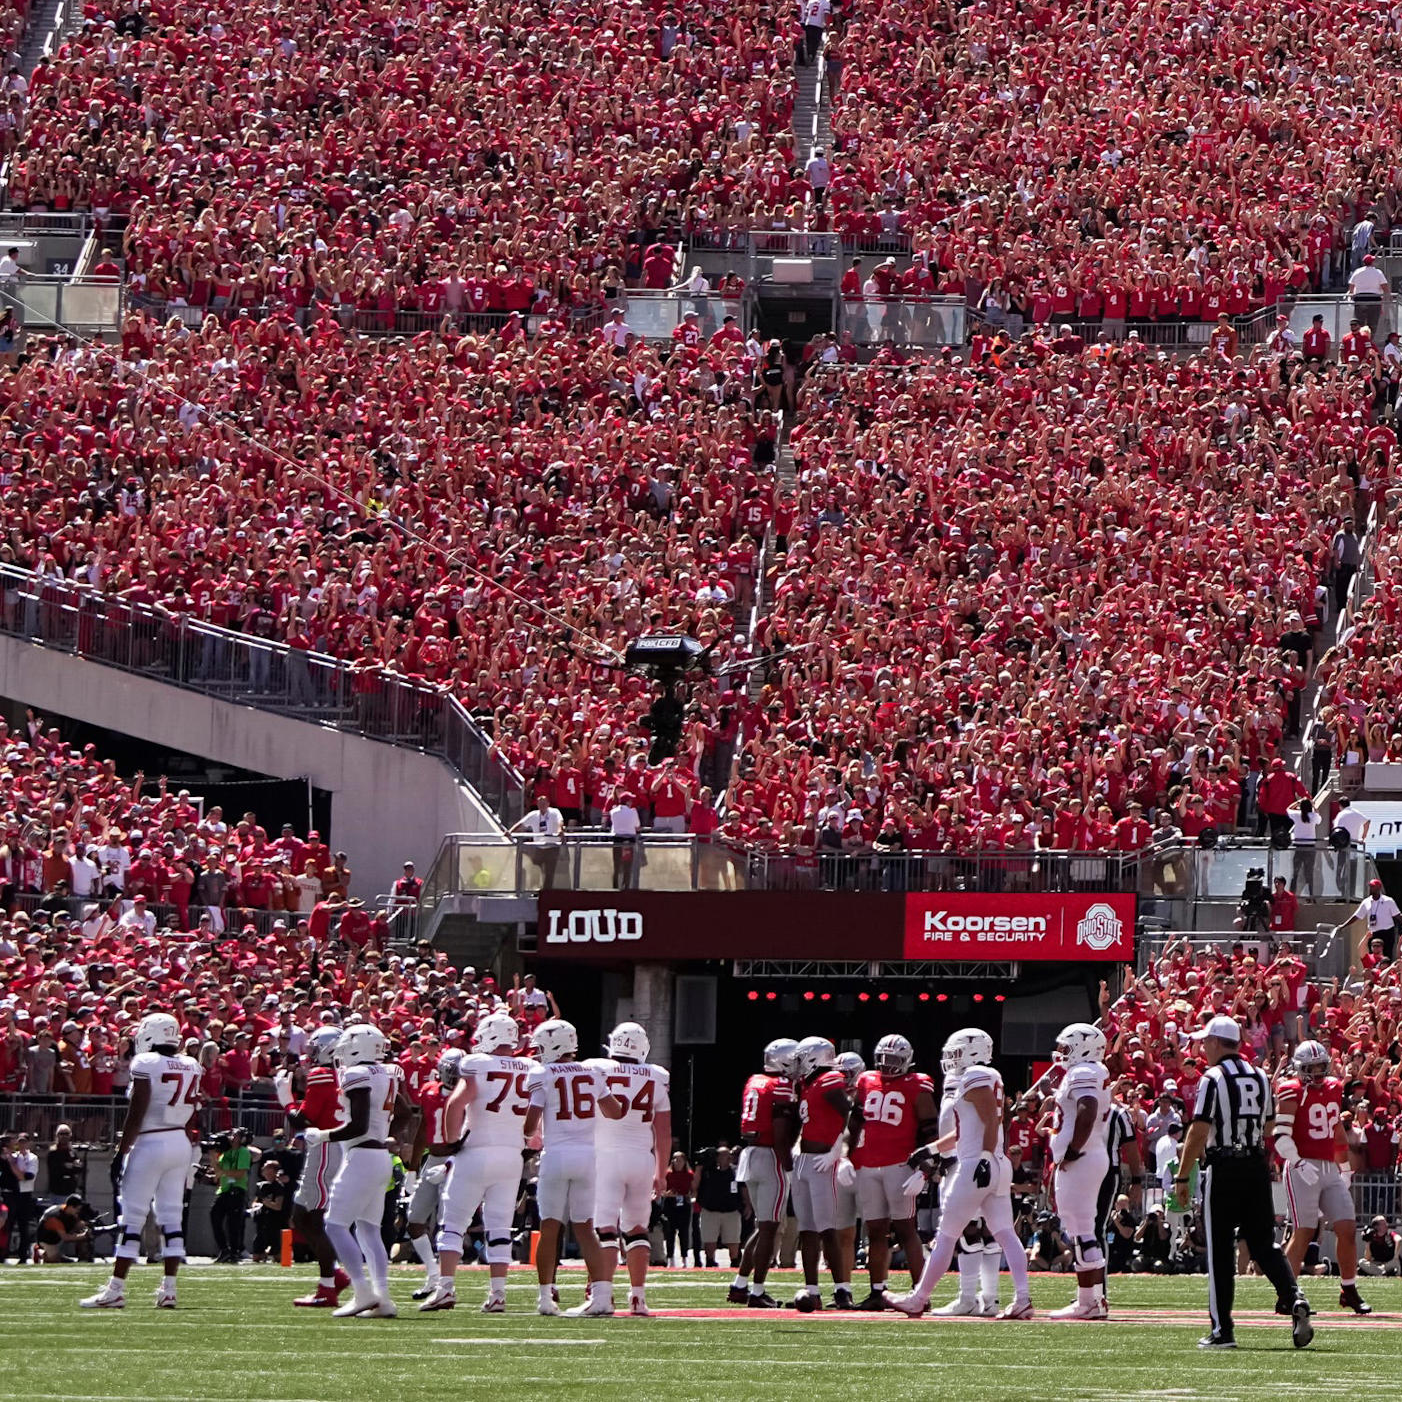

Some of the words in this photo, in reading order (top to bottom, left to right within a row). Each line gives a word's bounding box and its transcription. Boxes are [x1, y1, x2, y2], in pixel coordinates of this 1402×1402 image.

[53, 263, 68, 277] 34
[546, 909, 644, 944] LOUD
[923, 910, 1047, 932] Koorsen
[923, 932, 953, 943] FIRE
[960, 932, 970, 942] &
[976, 932, 1047, 943] SECURITY
[161, 1073, 200, 1107] 74
[554, 1075, 595, 1121] 16
[1235, 1076, 1261, 1116] R
[863, 1090, 905, 1127] 96
[1307, 1101, 1340, 1140] 92
